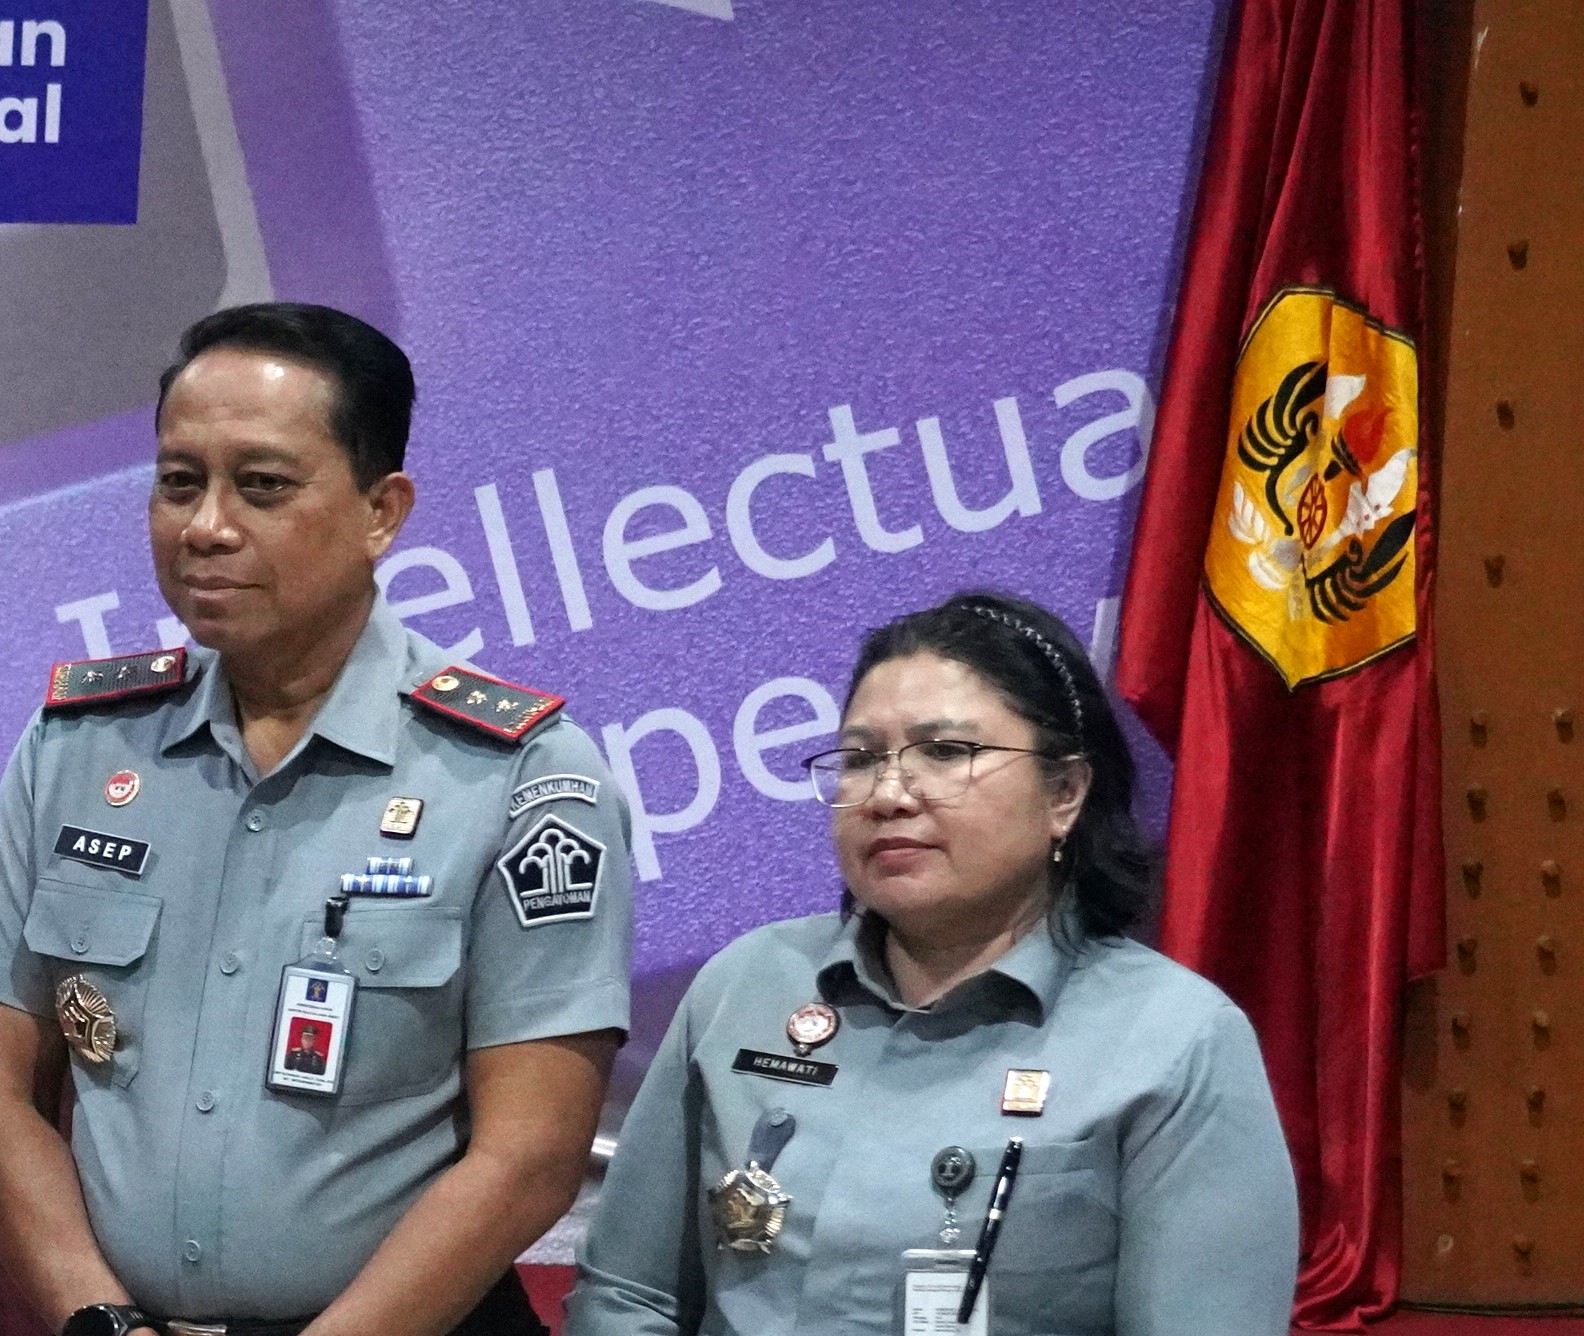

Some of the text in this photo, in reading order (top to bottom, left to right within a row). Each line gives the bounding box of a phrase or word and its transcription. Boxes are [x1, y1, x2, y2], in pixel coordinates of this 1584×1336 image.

[72, 835, 133, 861] ASEP
[522, 890, 592, 912] PENGAYOMAN
[753, 1056, 819, 1076] HEMAWATI
